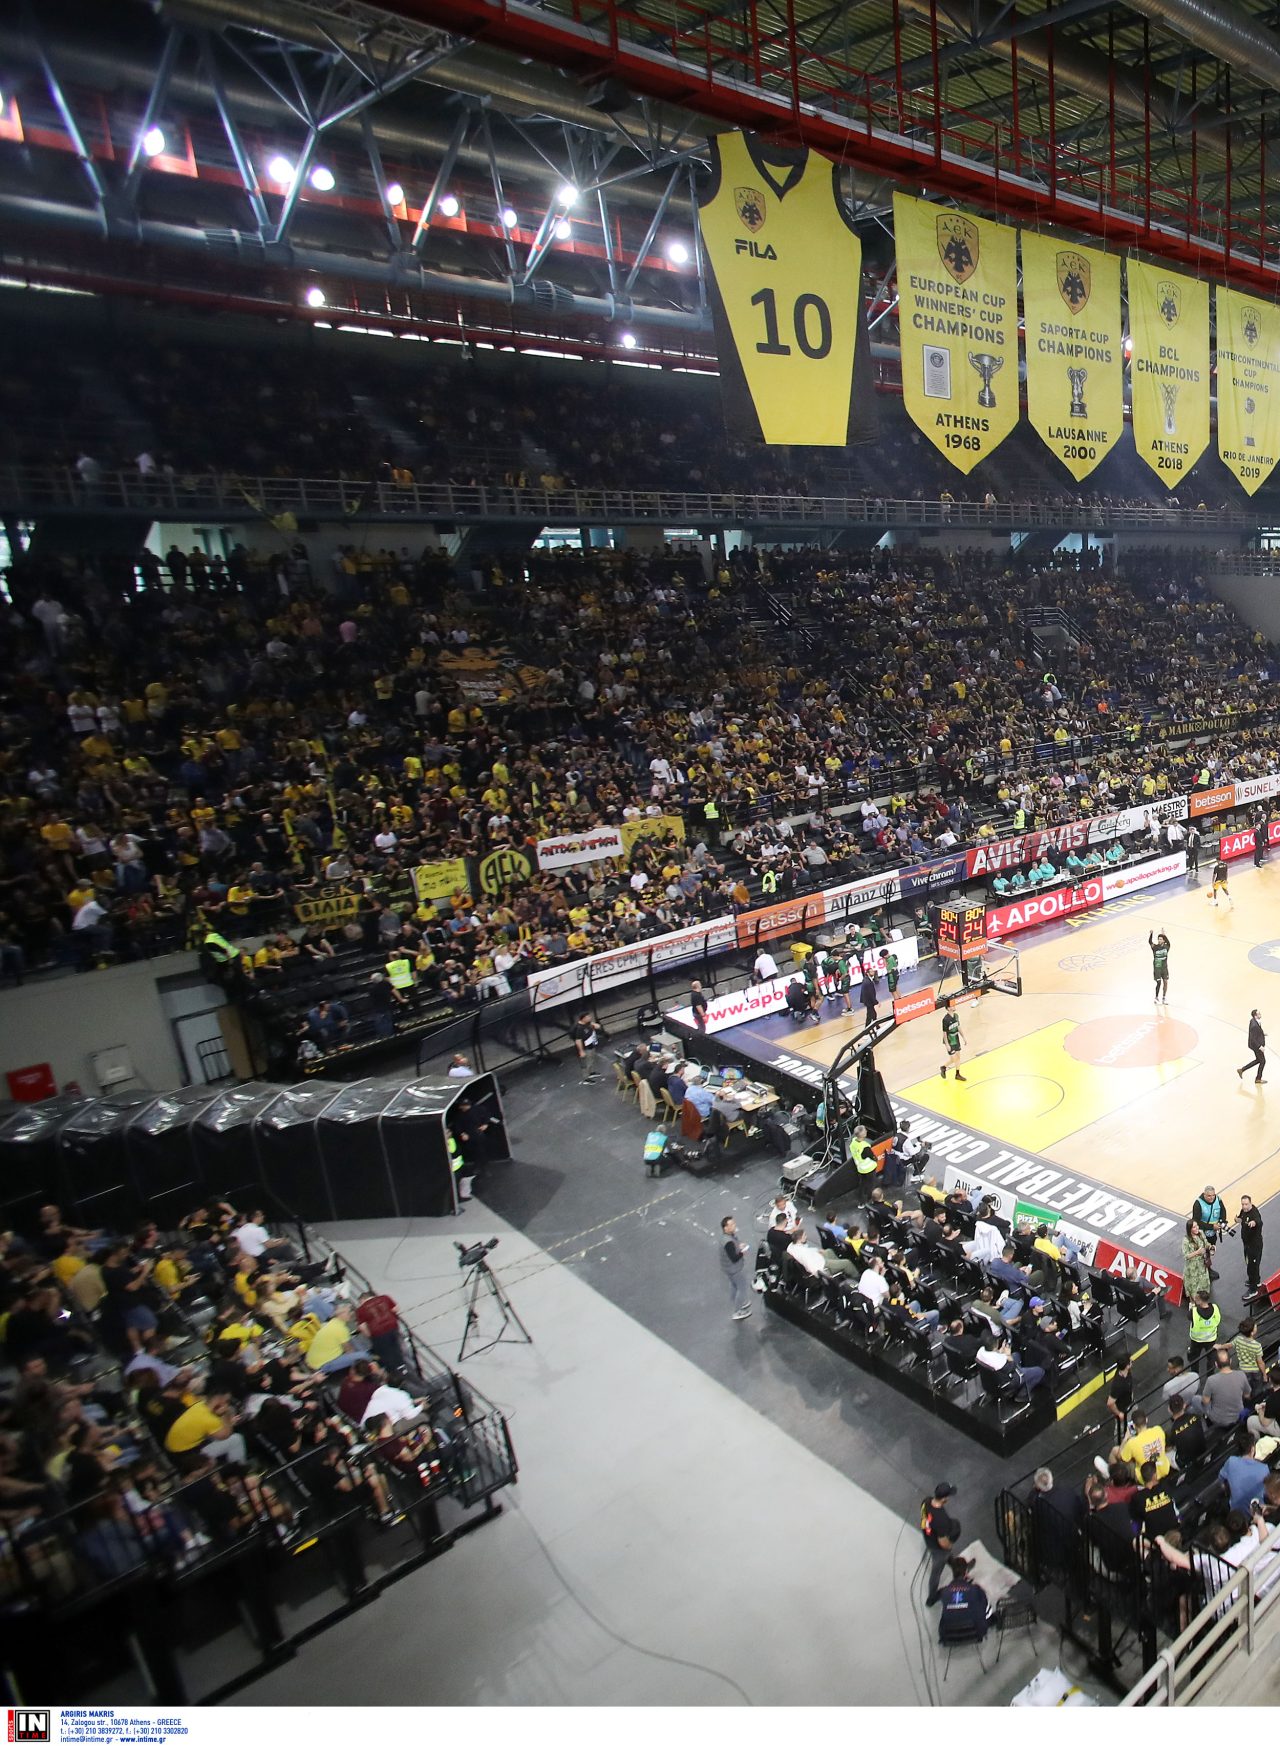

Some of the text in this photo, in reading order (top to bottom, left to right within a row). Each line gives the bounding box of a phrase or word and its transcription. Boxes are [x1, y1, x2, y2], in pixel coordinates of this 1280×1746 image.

[734, 238, 778, 260] FILA
[910, 275, 1006, 309] EUROPEAN CUP
[750, 287, 833, 360] 10
[980, 310, 1003, 325] CUP
[912, 312, 1005, 345] CHAMPIONS
[1040, 322, 1109, 344] SAPORTA CUP
[1038, 338, 1112, 363] CHAMPIONS
[1159, 345, 1180, 361] BCL
[1137, 359, 1200, 383] CHAMPIONS
[1218, 351, 1280, 373] INTERCONTINENTAL
[1243, 369, 1257, 379] CUP
[1232, 377, 1269, 393] CHAMPIONS
[936, 413, 989, 431] ATHENS
[944, 433, 981, 451] 1968
[1048, 426, 1108, 443] LAUSANNE
[1063, 444, 1096, 460] 2000
[1151, 439, 1189, 454] ATHENS
[1157, 456, 1183, 470] 2018
[1222, 450, 1274, 466] RIO DE JANEIRO
[1240, 466, 1260, 478] 2019
[1194, 790, 1232, 809] betsson
[1243, 782, 1274, 798] SUNEL
[972, 839, 1026, 875] AVIS
[830, 888, 876, 912] Allianz
[1006, 883, 1101, 928] APOLLO
[1065, 894, 1157, 928] ATHENS
[940, 922, 956, 940] 24
[963, 919, 983, 940] 24
[963, 943, 986, 955] betsson
[896, 997, 932, 1016] betsson
[987, 1150, 1178, 1248] BASKETBALL
[1108, 1250, 1168, 1288] AVIS
